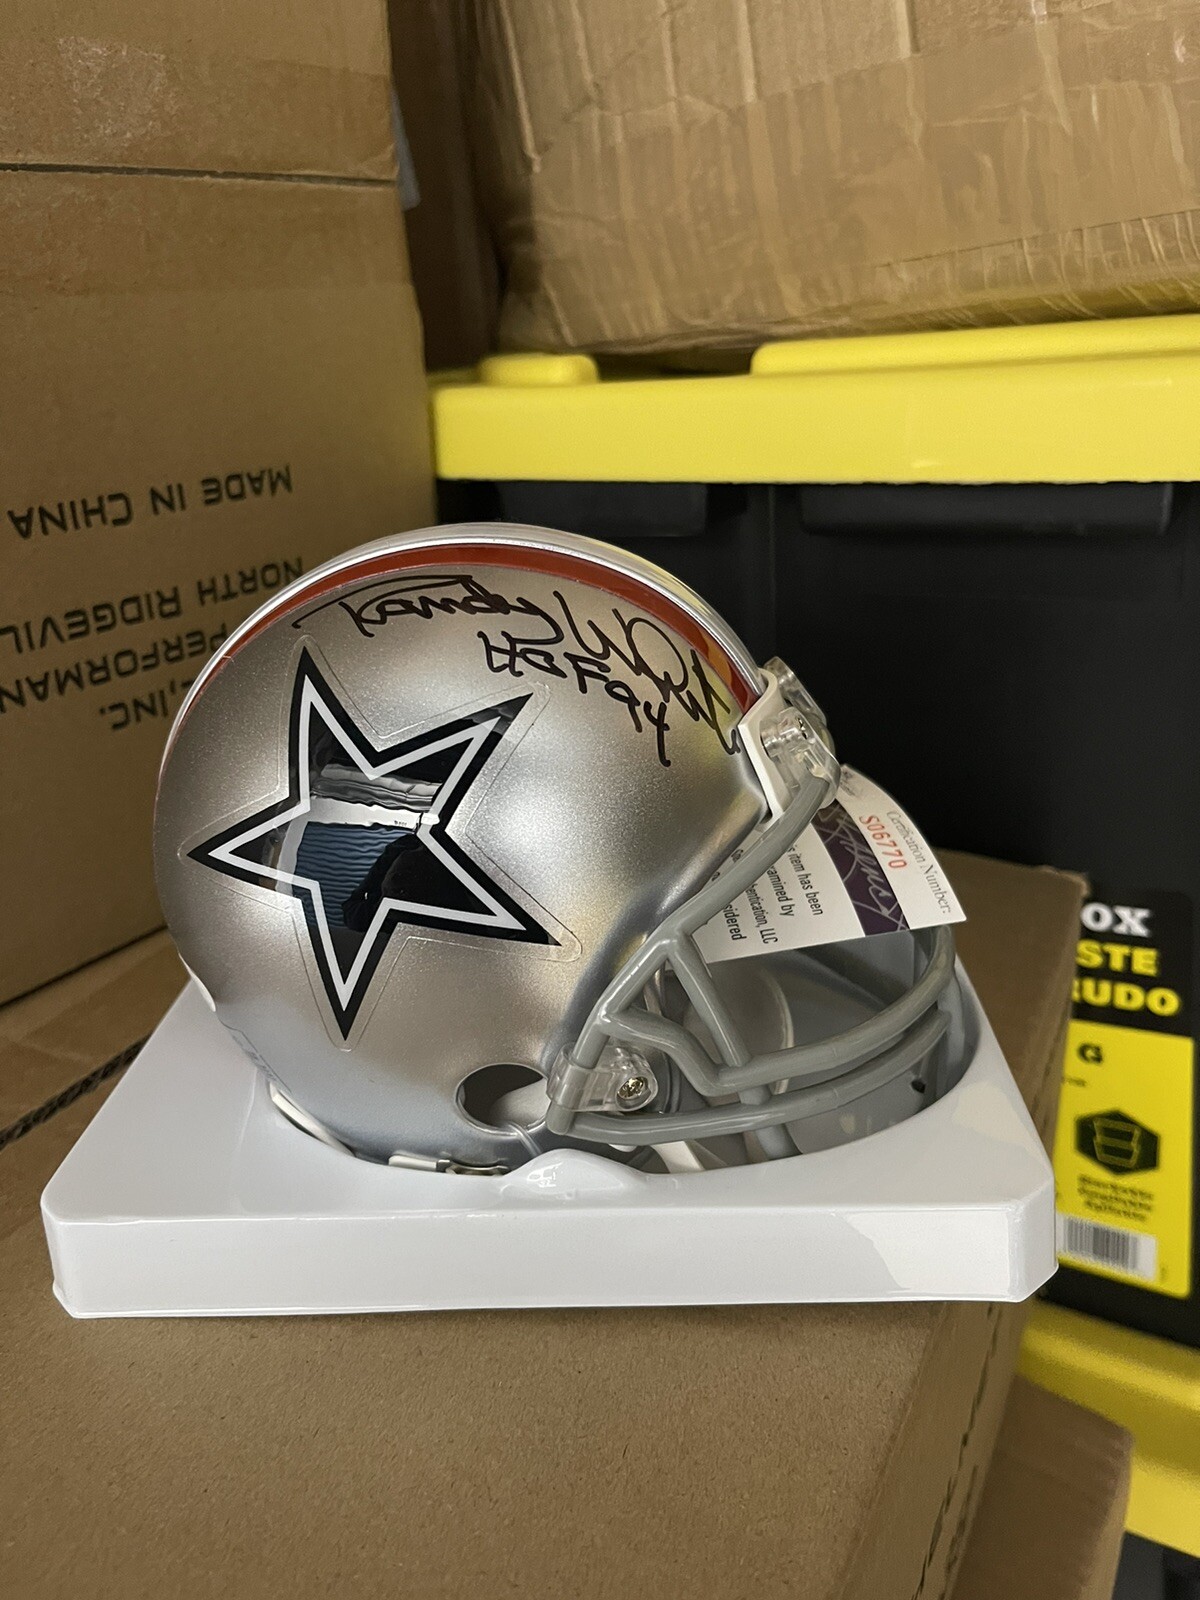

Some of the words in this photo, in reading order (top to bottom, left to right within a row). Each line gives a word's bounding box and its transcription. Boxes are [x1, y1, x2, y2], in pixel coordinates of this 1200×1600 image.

[149, 483, 187, 516] IN
[201, 464, 293, 505] MADE
[7, 492, 133, 540] CHINA
[196, 557, 304, 606] NORTH
[859, 814, 907, 868] S06770
[798, 872, 813, 891] has
[779, 903, 796, 917] by
[805, 891, 824, 916] been
[1081, 902, 1152, 937] OX
[759, 927, 779, 944] LLC
[1075, 939, 1158, 977] STE
